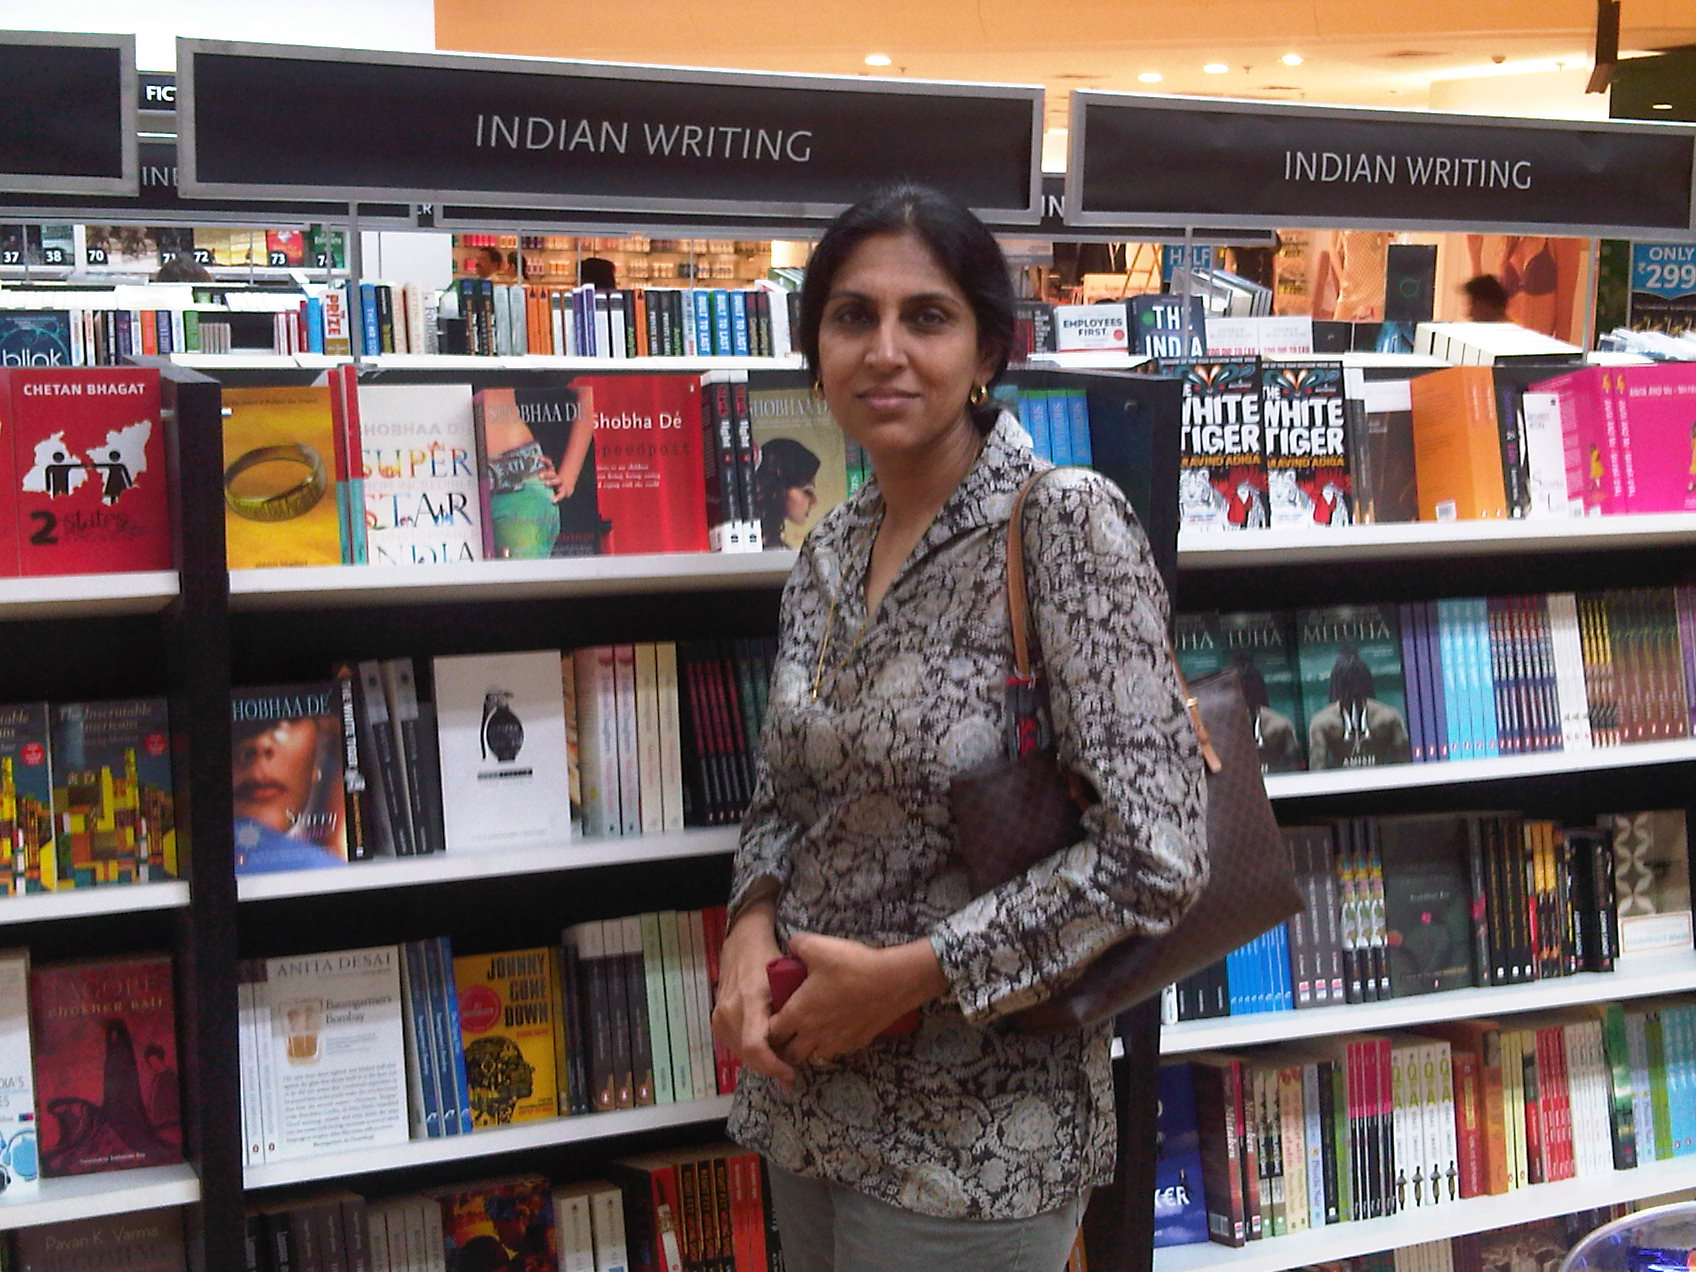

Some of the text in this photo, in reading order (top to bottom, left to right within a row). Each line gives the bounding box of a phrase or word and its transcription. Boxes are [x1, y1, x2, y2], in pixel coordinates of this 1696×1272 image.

[475, 113, 813, 163] INDIAN WRITING
[142, 166, 178, 187] IN
[1284, 150, 1533, 190] INDIAN WRITING
[3, 251, 20, 263] 37
[46, 250, 62, 262] 38
[88, 250, 104, 262] 70
[193, 251, 209, 263] 72
[270, 252, 286, 265] 73
[1169, 251, 1211, 266] HLF
[1648, 246, 1695, 261] ONLY
[325, 294, 342, 336] PRIZE
[700, 319, 709, 330] TO
[717, 293, 729, 351] BUILT TO LAST
[736, 319, 745, 330] TO
[1063, 318, 1123, 329] EMPLOYEES
[700, 331, 710, 352] LAST
[737, 331, 747, 351] LAST
[1078, 327, 1106, 338] FIRST
[1146, 335, 1204, 357] INDA
[24, 383, 145, 397] CHETAN BHAGAT
[593, 410, 682, 430] Shobha Dé
[1264, 397, 1344, 428] WHITE
[362, 423, 441, 436] HOBHAA
[1181, 424, 1260, 455] TIGER
[1265, 426, 1345, 456] TIGER
[363, 442, 473, 479] SUPER
[365, 491, 473, 530] STAR
[30, 511, 59, 546] 2
[232, 696, 304, 722] HOBHAA
[278, 951, 391, 977] ANITA DESAI
[1224, 1104, 1238, 1159] Mistaken
